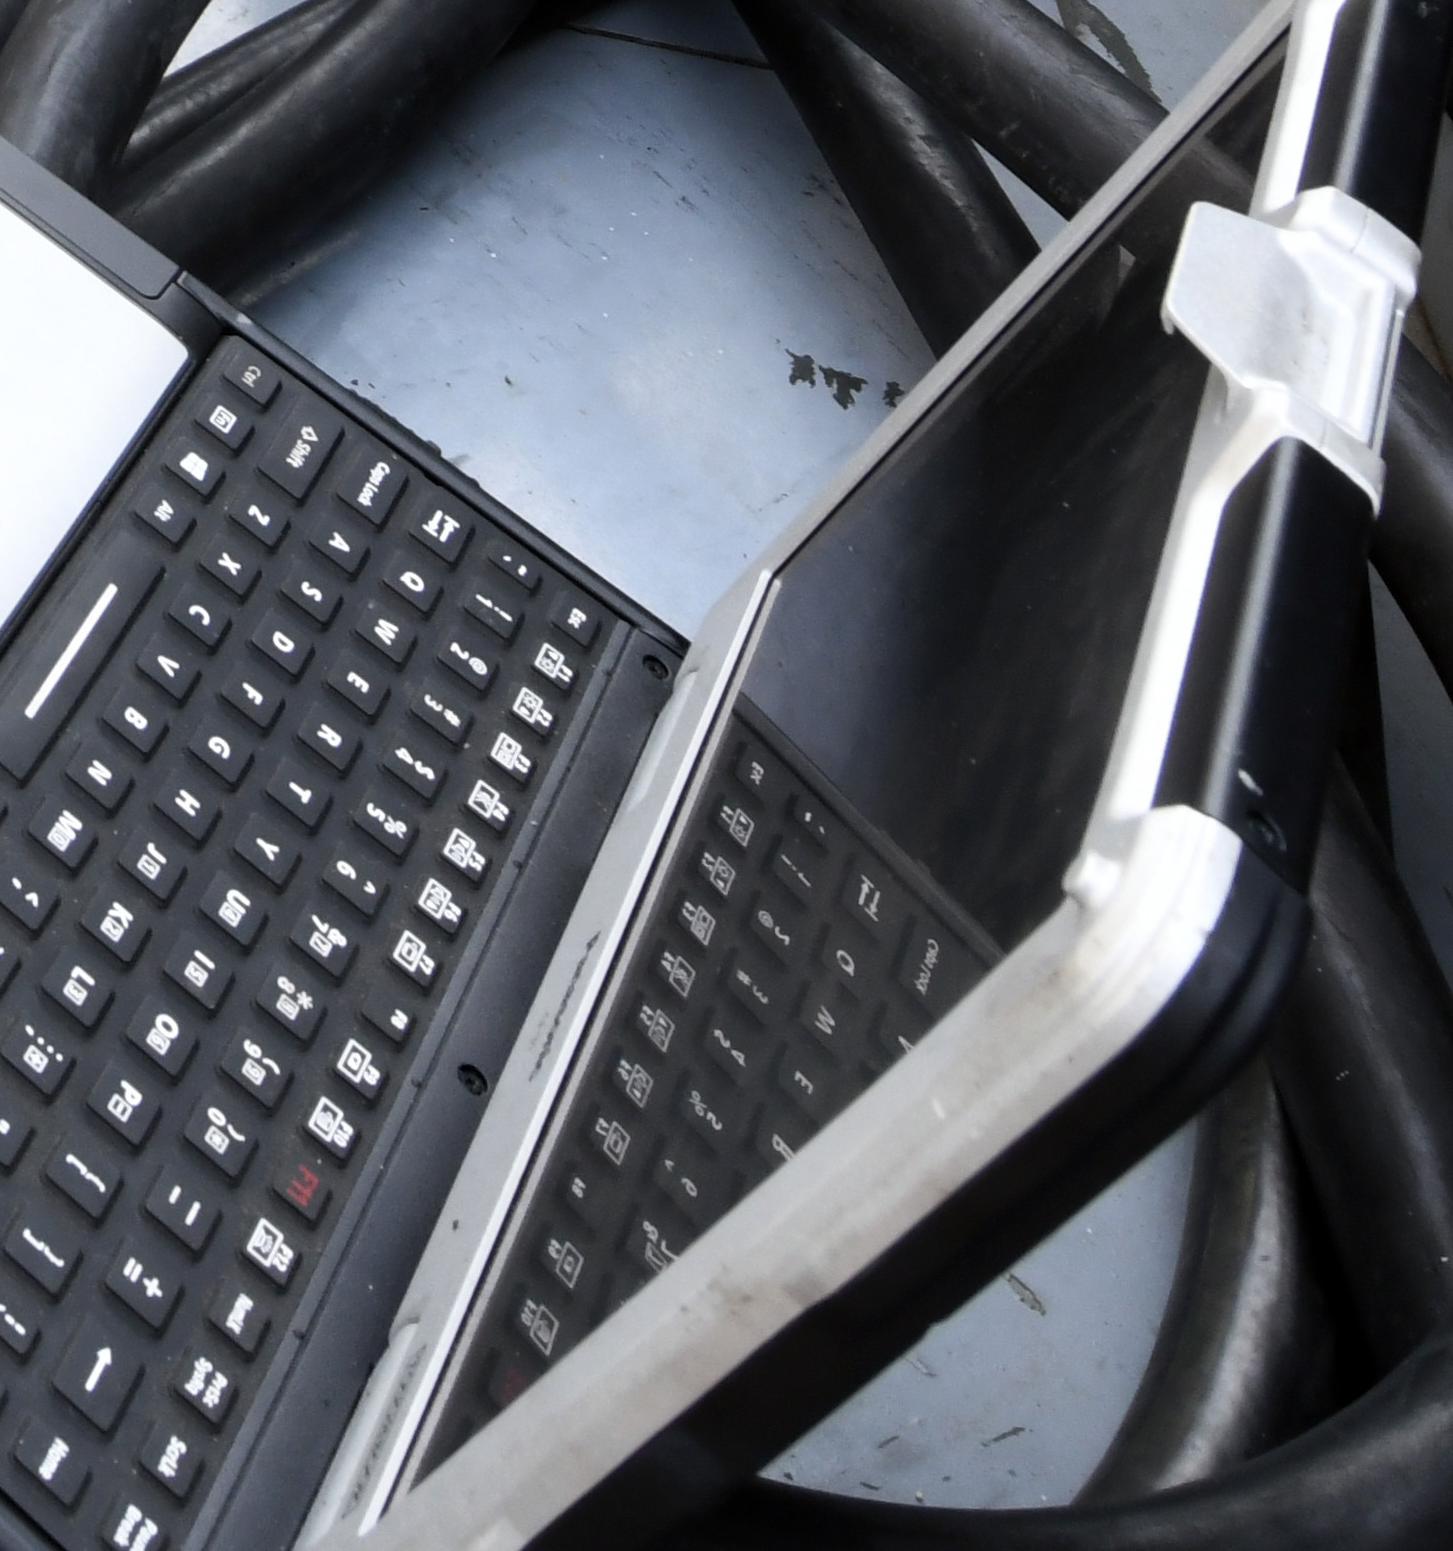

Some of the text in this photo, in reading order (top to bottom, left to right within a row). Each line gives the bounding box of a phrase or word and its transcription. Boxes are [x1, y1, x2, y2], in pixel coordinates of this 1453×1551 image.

[286, 439, 311, 468] Shift
[372, 462, 391, 487] Caps
[154, 500, 174, 521] Alt
[248, 505, 270, 526] Z
[329, 532, 350, 552] A
[218, 552, 241, 575] X
[301, 581, 322, 602] S
[400, 571, 424, 592] Q
[476, 594, 493, 608] 1
[189, 605, 210, 625] C
[568, 608, 586, 628] Esc
[273, 631, 294, 653] D
[374, 619, 399, 645] W
[450, 642, 469, 660] 2
[157, 655, 180, 677] V
[557, 665, 574, 683] F1
[347, 672, 369, 693] E
[242, 683, 263, 705] F
[424, 694, 443, 711] 3
[124, 707, 148, 730] B
[536, 710, 553, 727] F2
[317, 724, 342, 747] R
[208, 736, 230, 759] G
[395, 747, 414, 764] 4
[87, 760, 112, 786] N
[514, 756, 532, 774] F3
[175, 789, 200, 816] H
[289, 782, 312, 804] T
[367, 803, 387, 822] 5
[492, 802, 510, 822] F4
[56, 810, 82, 840] M
[147, 842, 167, 864] J
[256, 838, 280, 861] Y
[336, 861, 356, 880] 6
[468, 851, 486, 872] F5
[227, 889, 251, 914] U
[443, 901, 462, 923] F6
[108, 902, 133, 928] K
[311, 915, 329, 933] 7
[417, 954, 436, 976] F7
[71, 966, 95, 986] L
[277, 976, 295, 994] 8
[155, 1014, 179, 1041] O
[391, 1009, 408, 1030] F8
[243, 1039, 262, 1059] 9
[121, 1080, 142, 1102] P
[207, 1107, 226, 1127] 0
[272, 1242, 293, 1272] F12
[39, 1437, 69, 1480] Home
[129, 1518, 158, 1551] Paus
